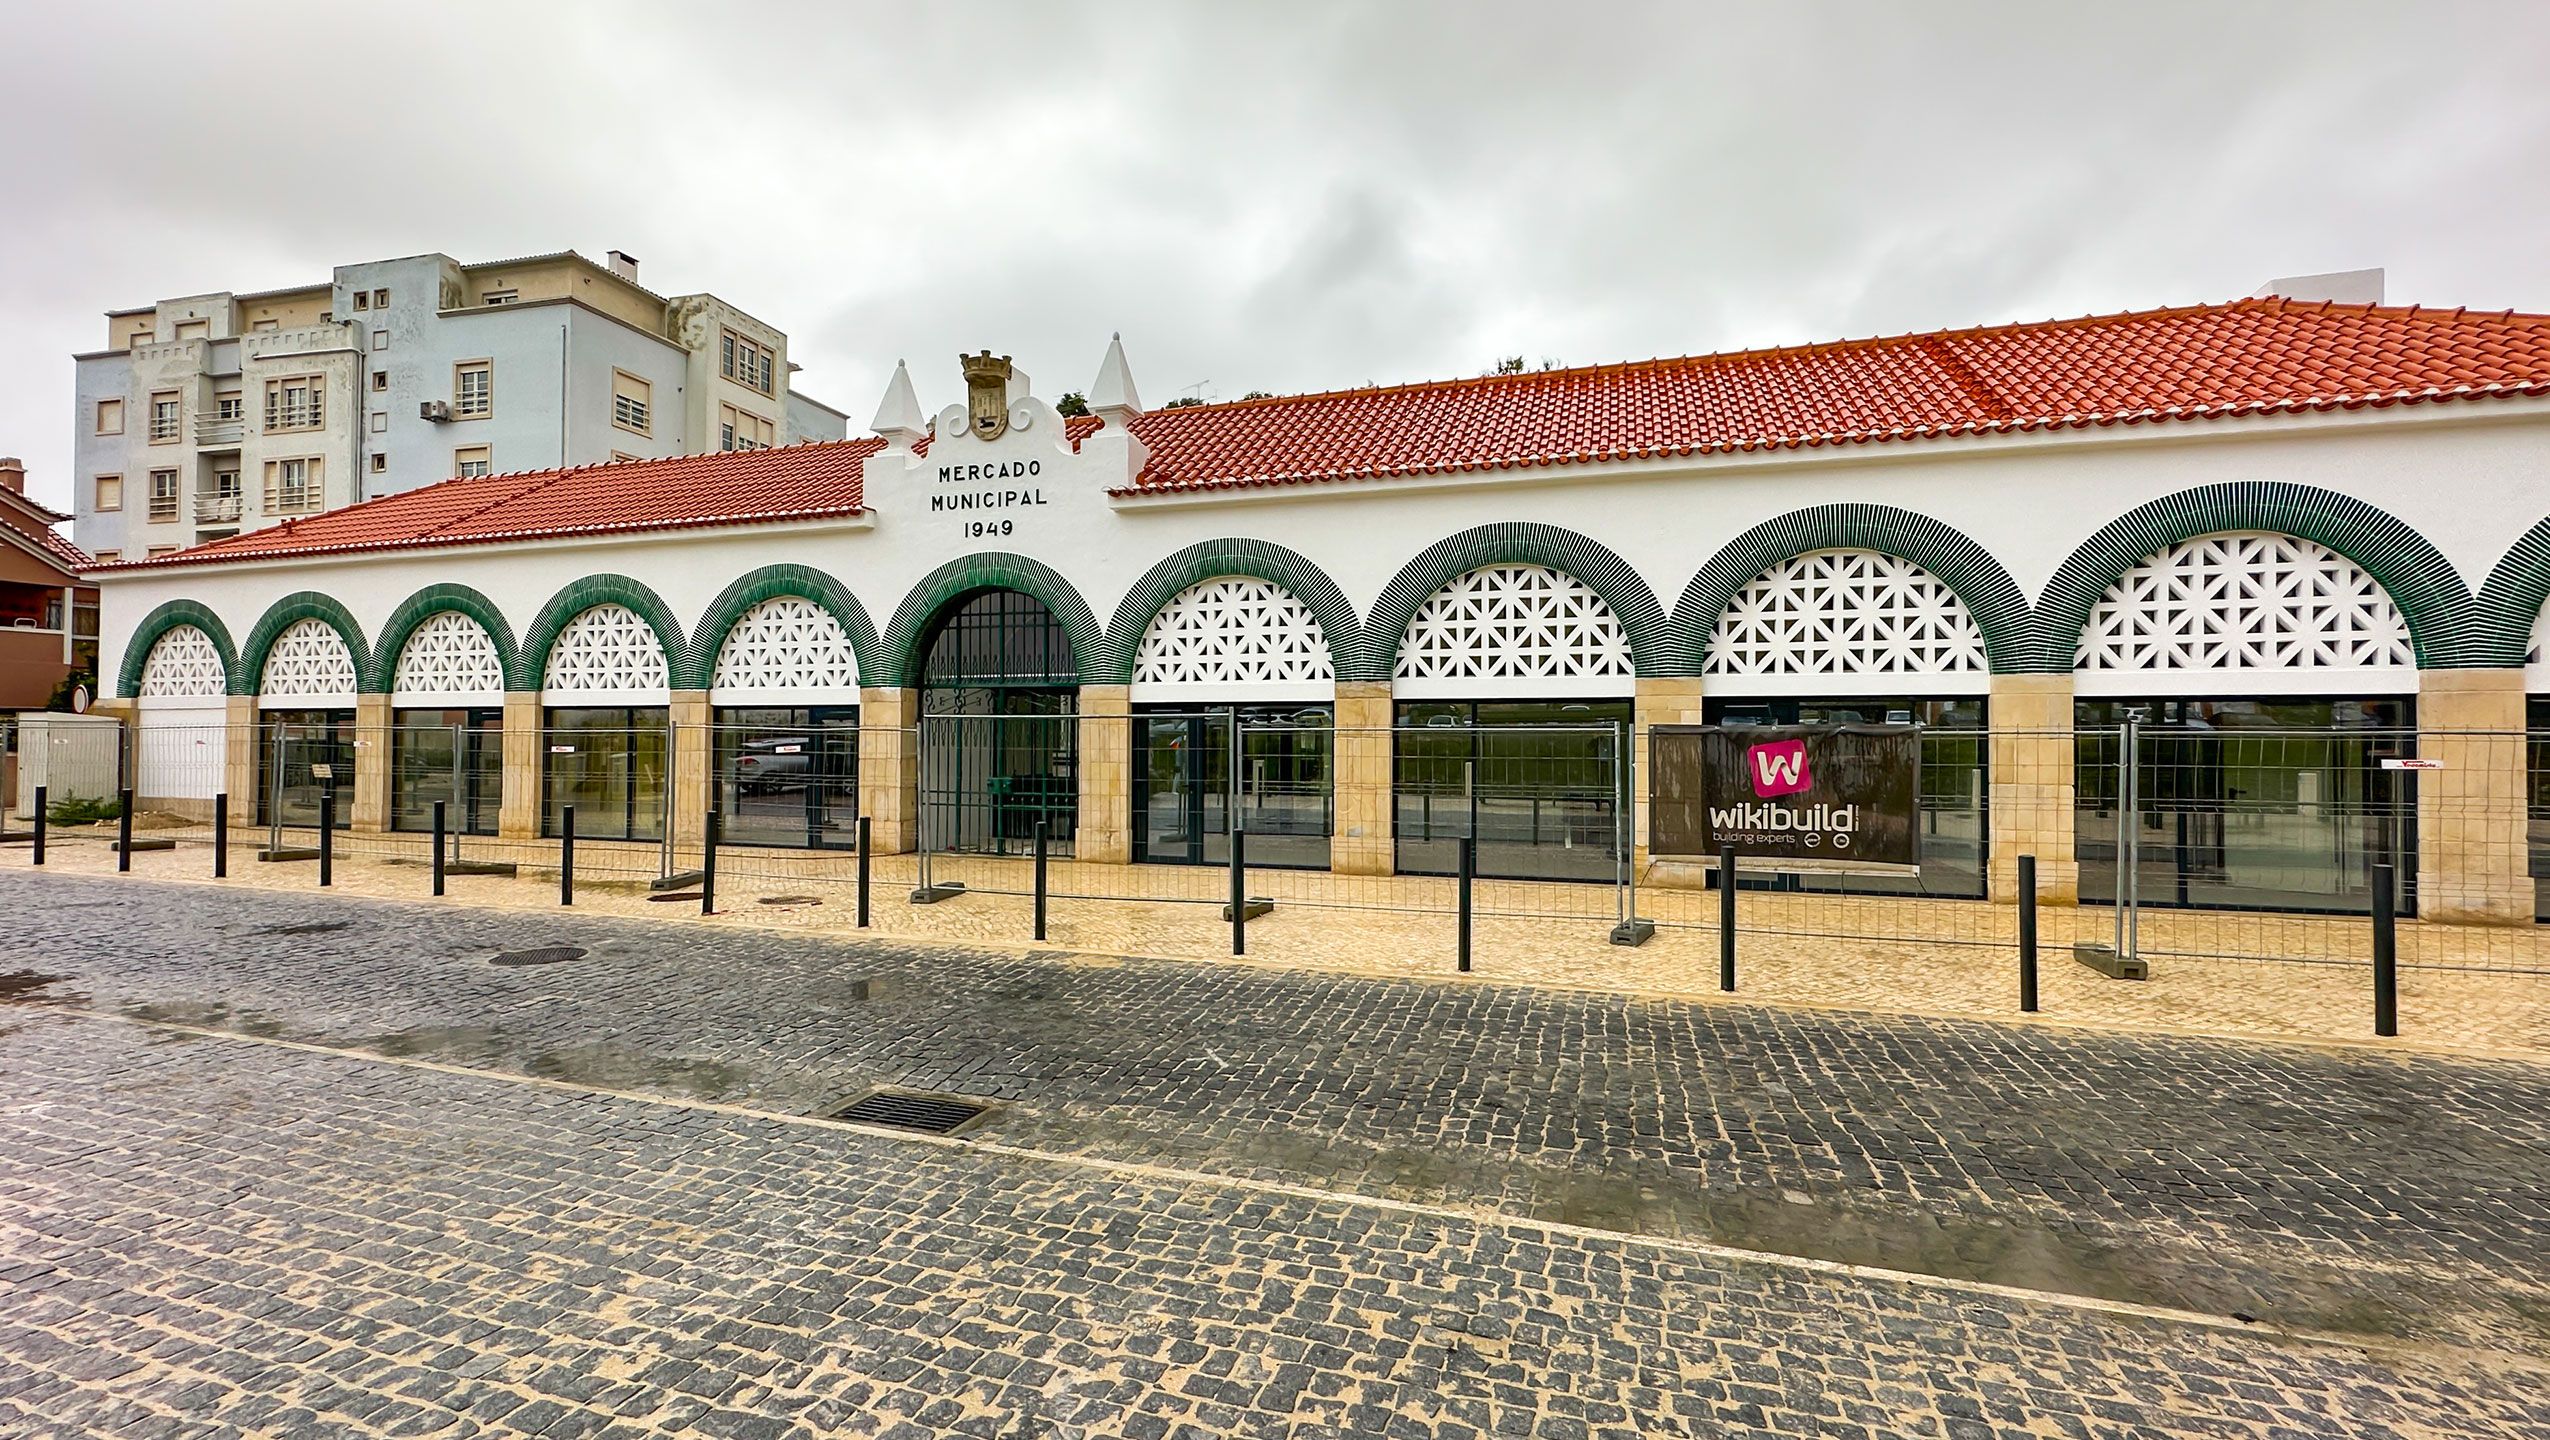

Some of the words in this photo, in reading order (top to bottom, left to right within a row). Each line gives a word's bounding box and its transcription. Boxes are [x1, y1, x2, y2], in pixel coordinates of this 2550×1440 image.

[939, 460, 1041, 483] MERCADO
[931, 488, 1047, 511] MUNICIPAL
[964, 519, 1013, 538] 1949
[1709, 802, 1853, 832] wikibuild
[1712, 831, 1754, 845] building
[1756, 834, 1796, 845] experts
